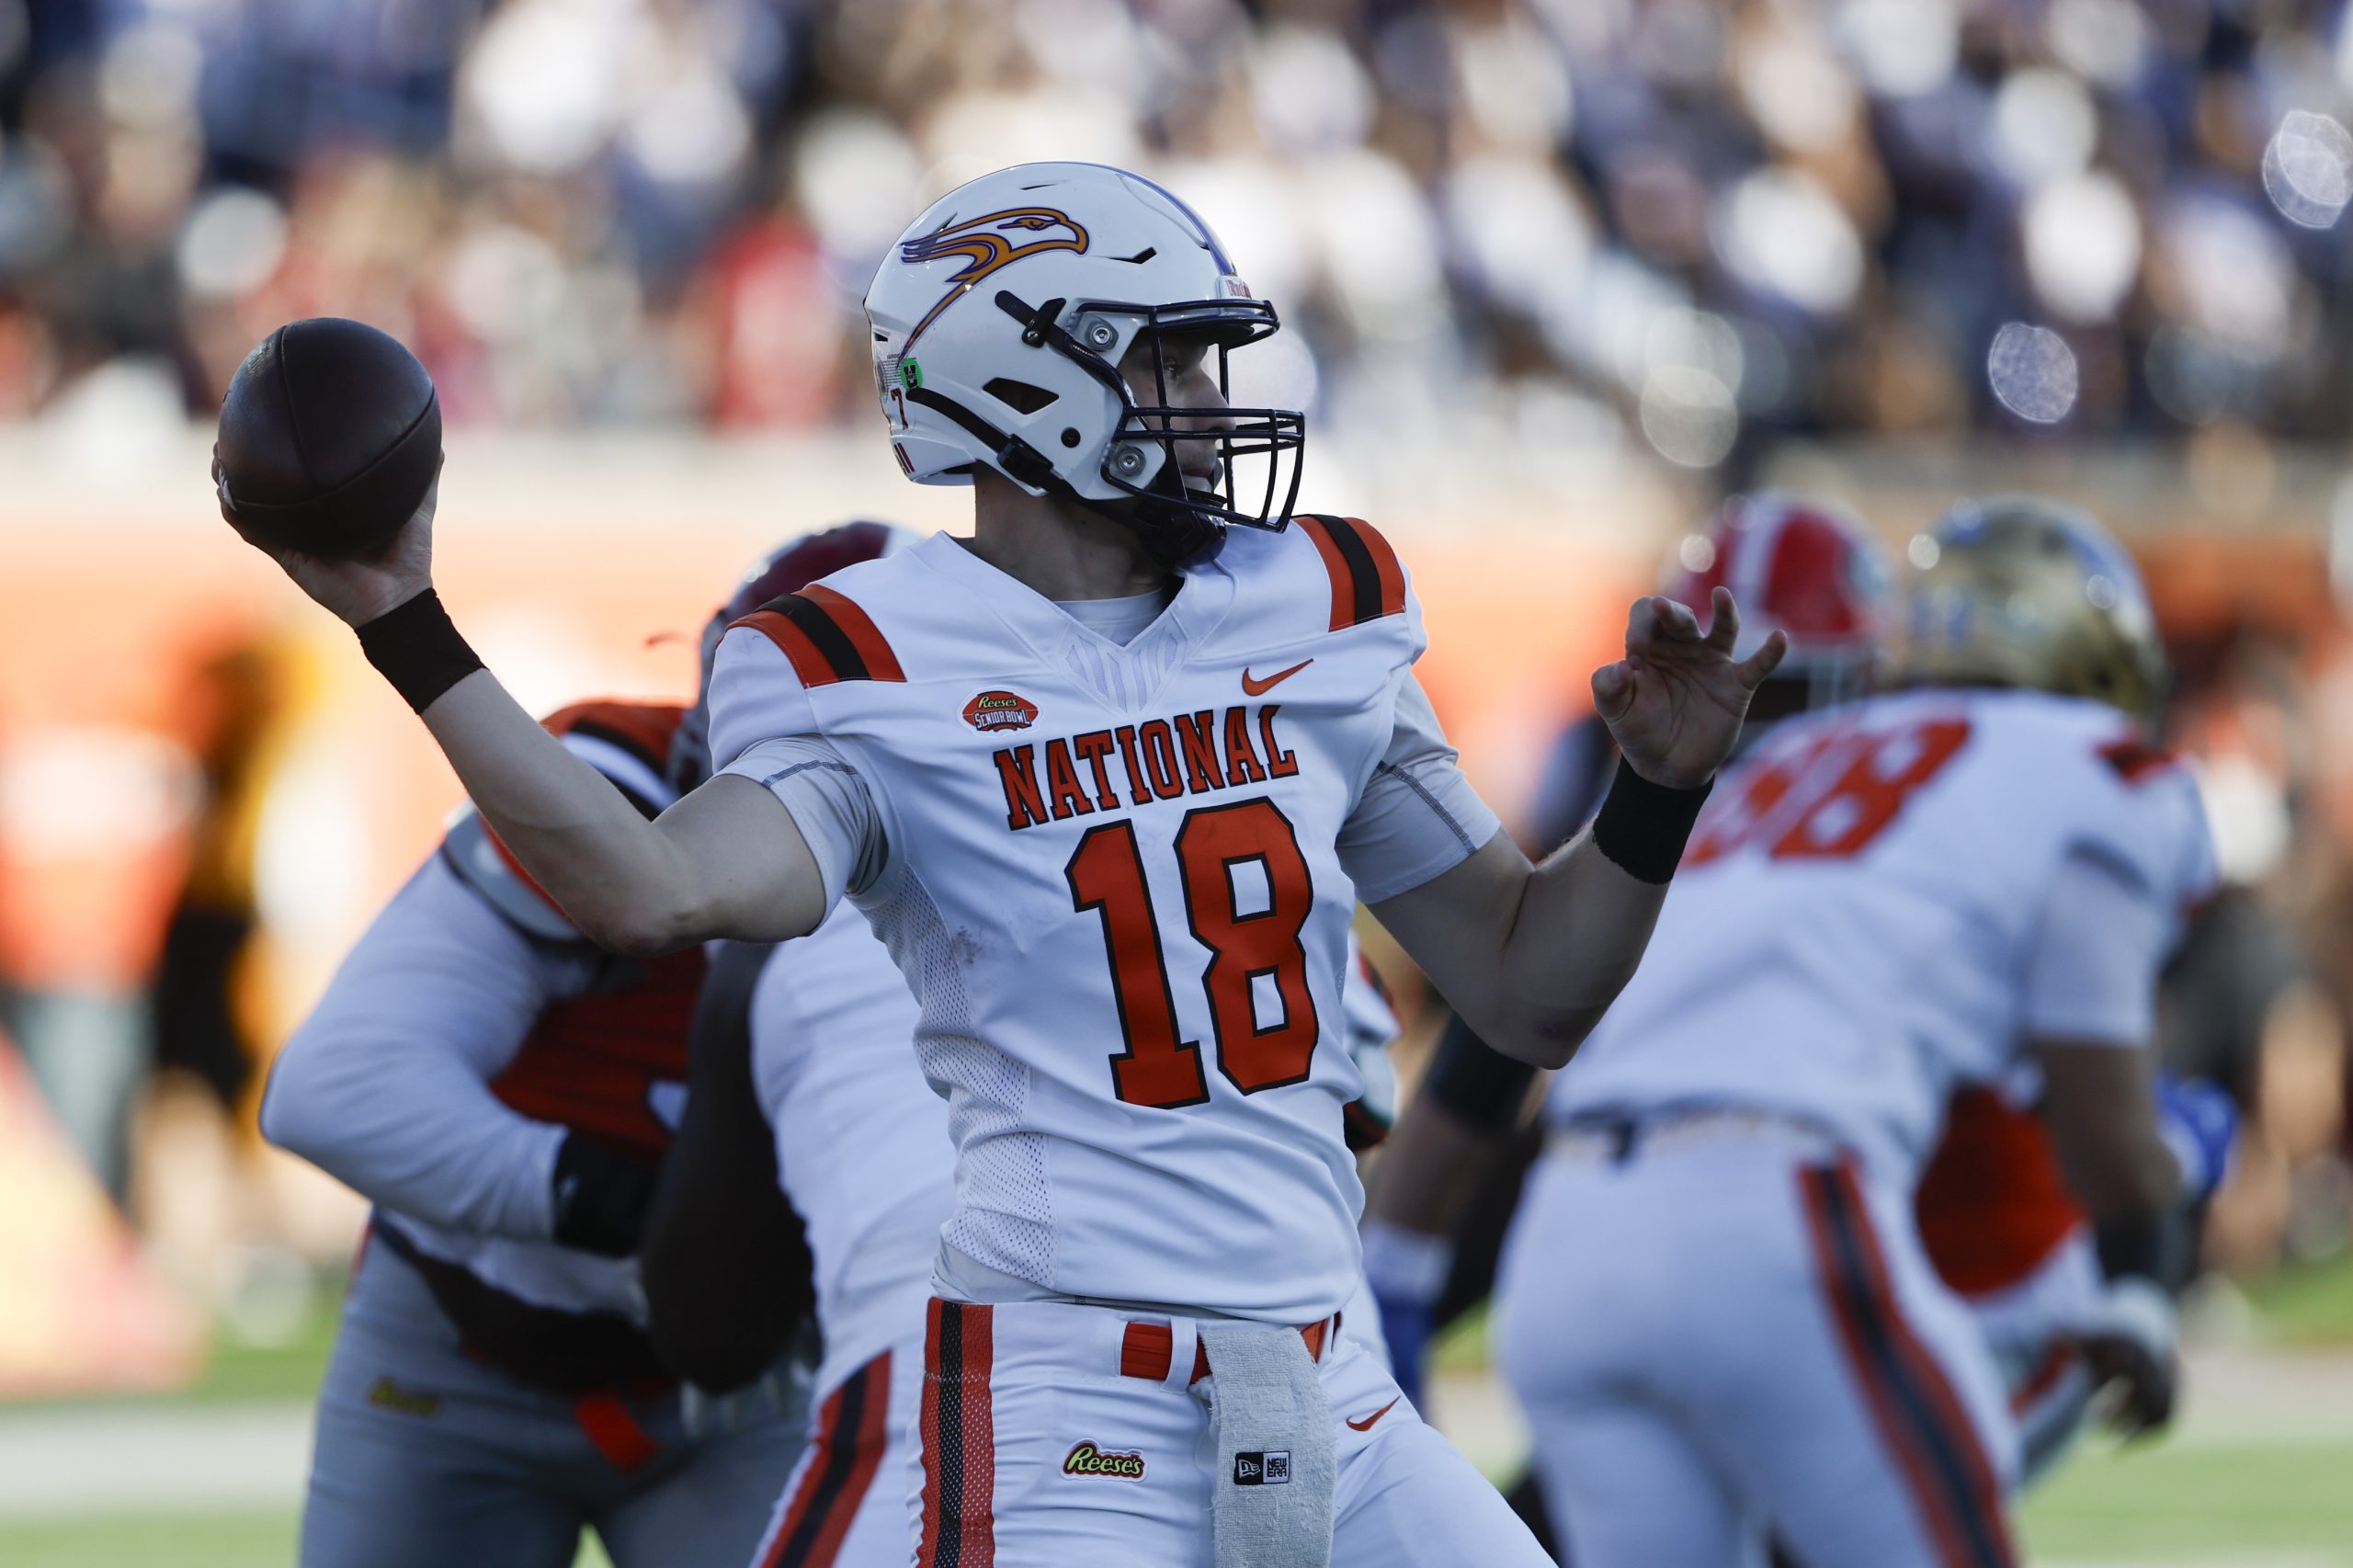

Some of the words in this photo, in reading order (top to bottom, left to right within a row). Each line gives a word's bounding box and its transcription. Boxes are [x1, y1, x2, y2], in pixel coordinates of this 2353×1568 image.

[978, 696, 1017, 708] Reese's
[974, 711, 1006, 729] SENIOR
[1006, 709, 1030, 724] BOWL
[993, 704, 1300, 830] NATIONAL
[1063, 795, 1320, 1109] 18
[1066, 1447, 1142, 1475] Reese's
[1267, 1457, 1288, 1469] NEW
[1267, 1467, 1288, 1478] ERA
